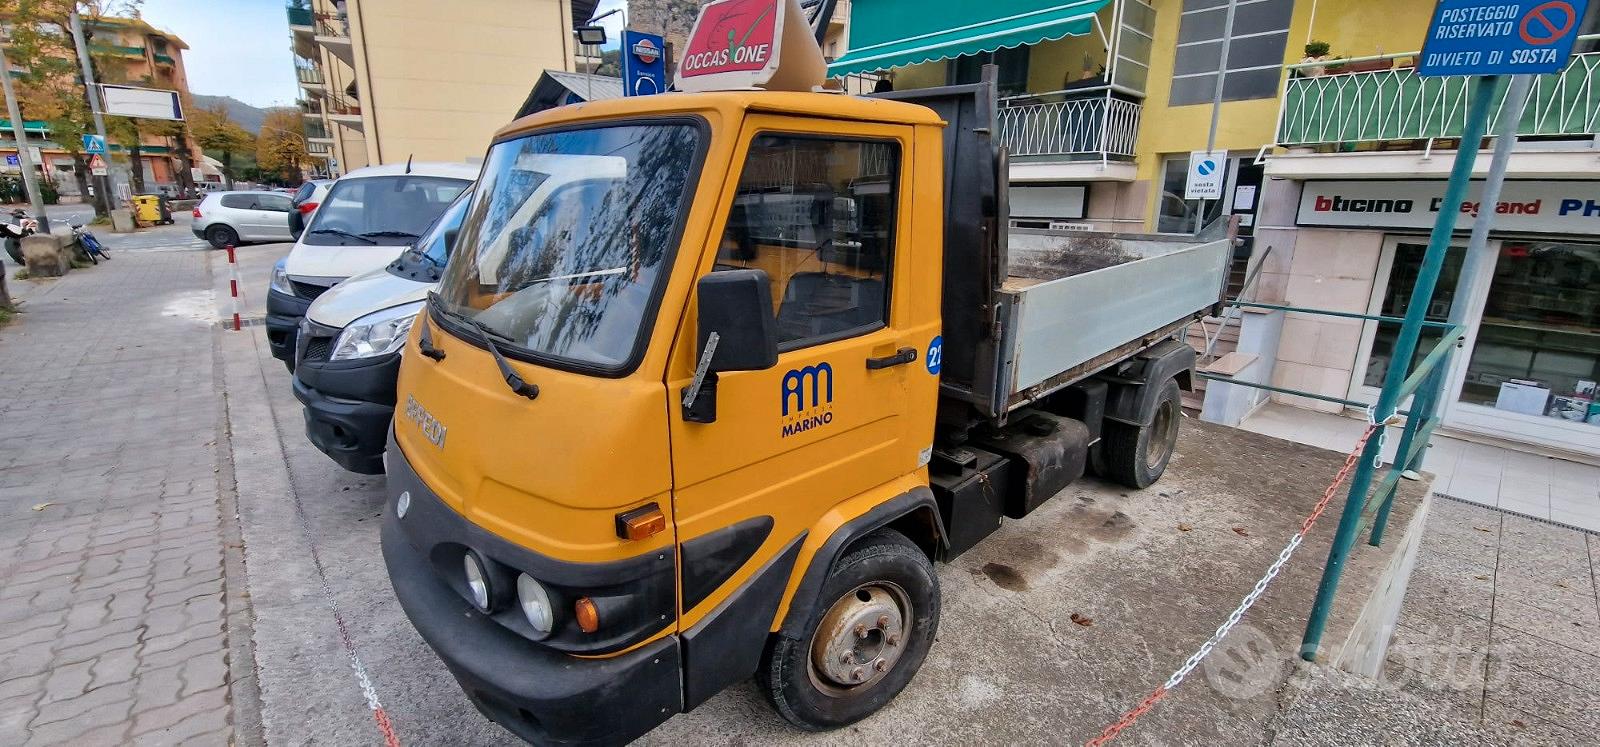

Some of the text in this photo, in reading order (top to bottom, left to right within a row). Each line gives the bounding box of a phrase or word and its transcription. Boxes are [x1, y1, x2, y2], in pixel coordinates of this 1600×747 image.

[1440, 4, 1520, 23] POSTEGGIO
[1435, 21, 1513, 40] RISERVATO
[1426, 48, 1557, 67] DIVIETO DI SOSTA
[1314, 195, 1414, 213] bticino
